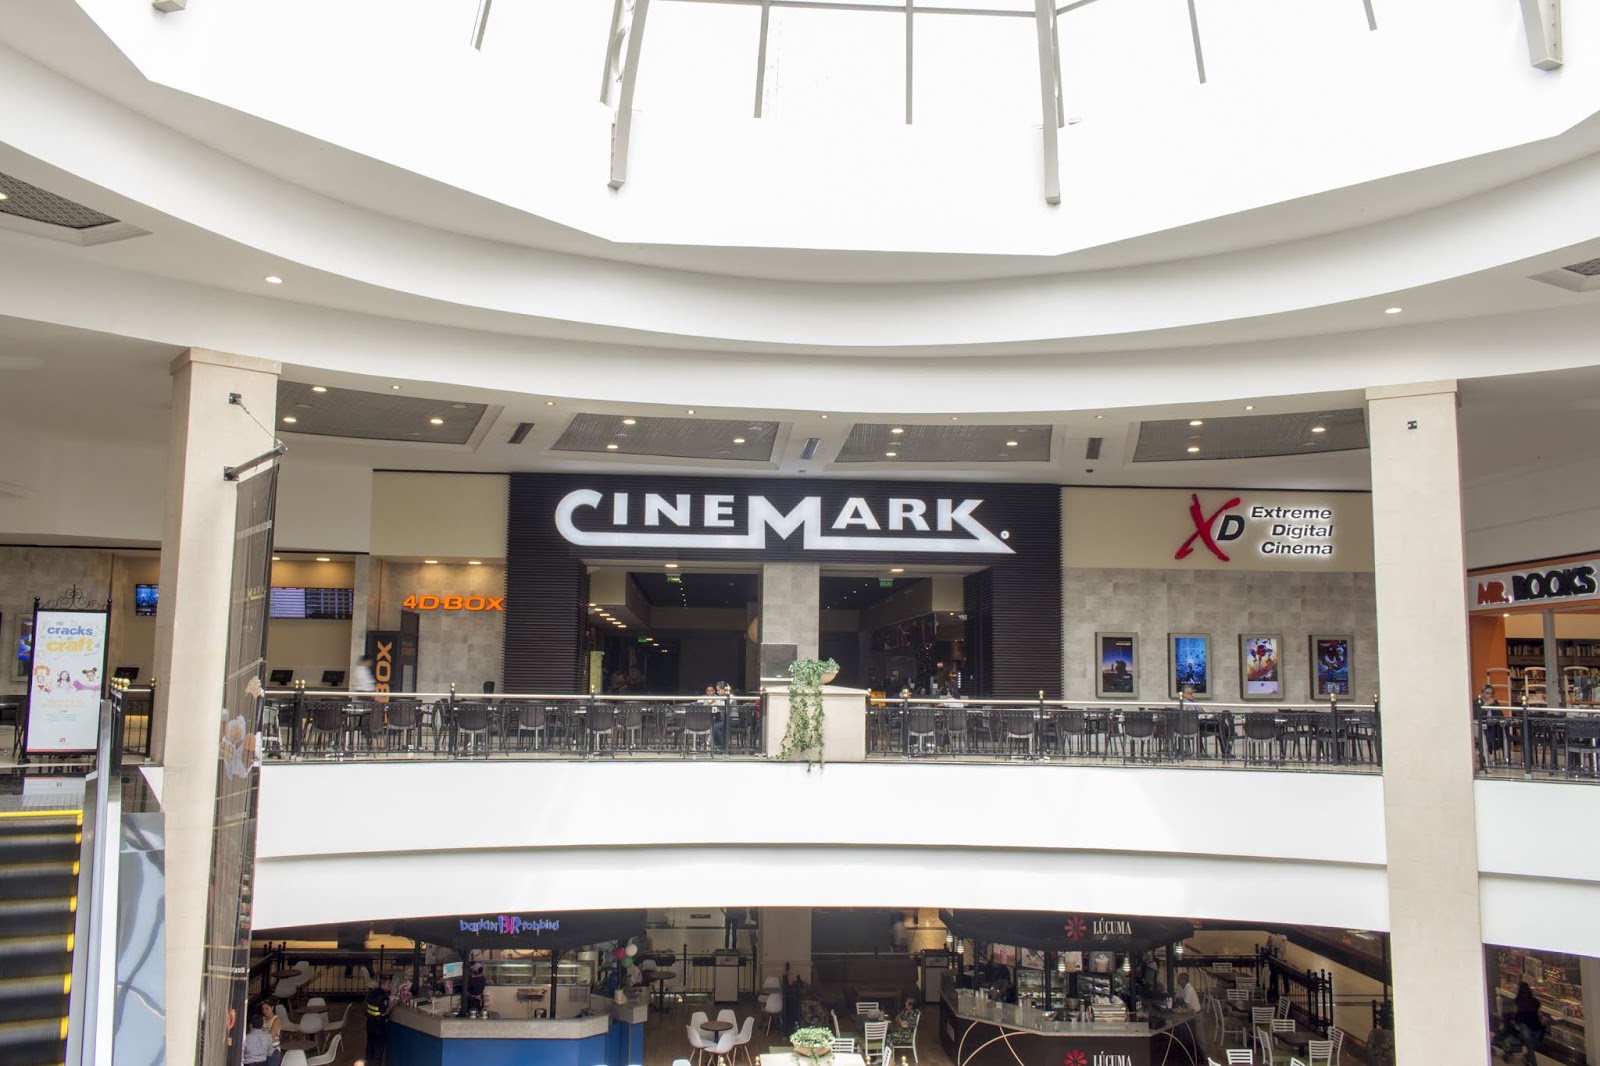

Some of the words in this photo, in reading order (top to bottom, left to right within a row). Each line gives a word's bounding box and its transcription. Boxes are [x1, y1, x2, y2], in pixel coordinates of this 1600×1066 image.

[1251, 506, 1332, 519] Extreme
[555, 488, 1017, 554] CINEMARK
[1272, 524, 1333, 539] Digital
[1261, 541, 1333, 555] Cinema
[1477, 581, 1510, 605] MR.
[1512, 566, 1597, 601] BOOKS
[47, 625, 94, 636] cracks
[46, 637, 94, 652] craft
[1093, 917, 1132, 935] LÚCUMA
[1093, 1050, 1132, 1066] LÚCUMA
